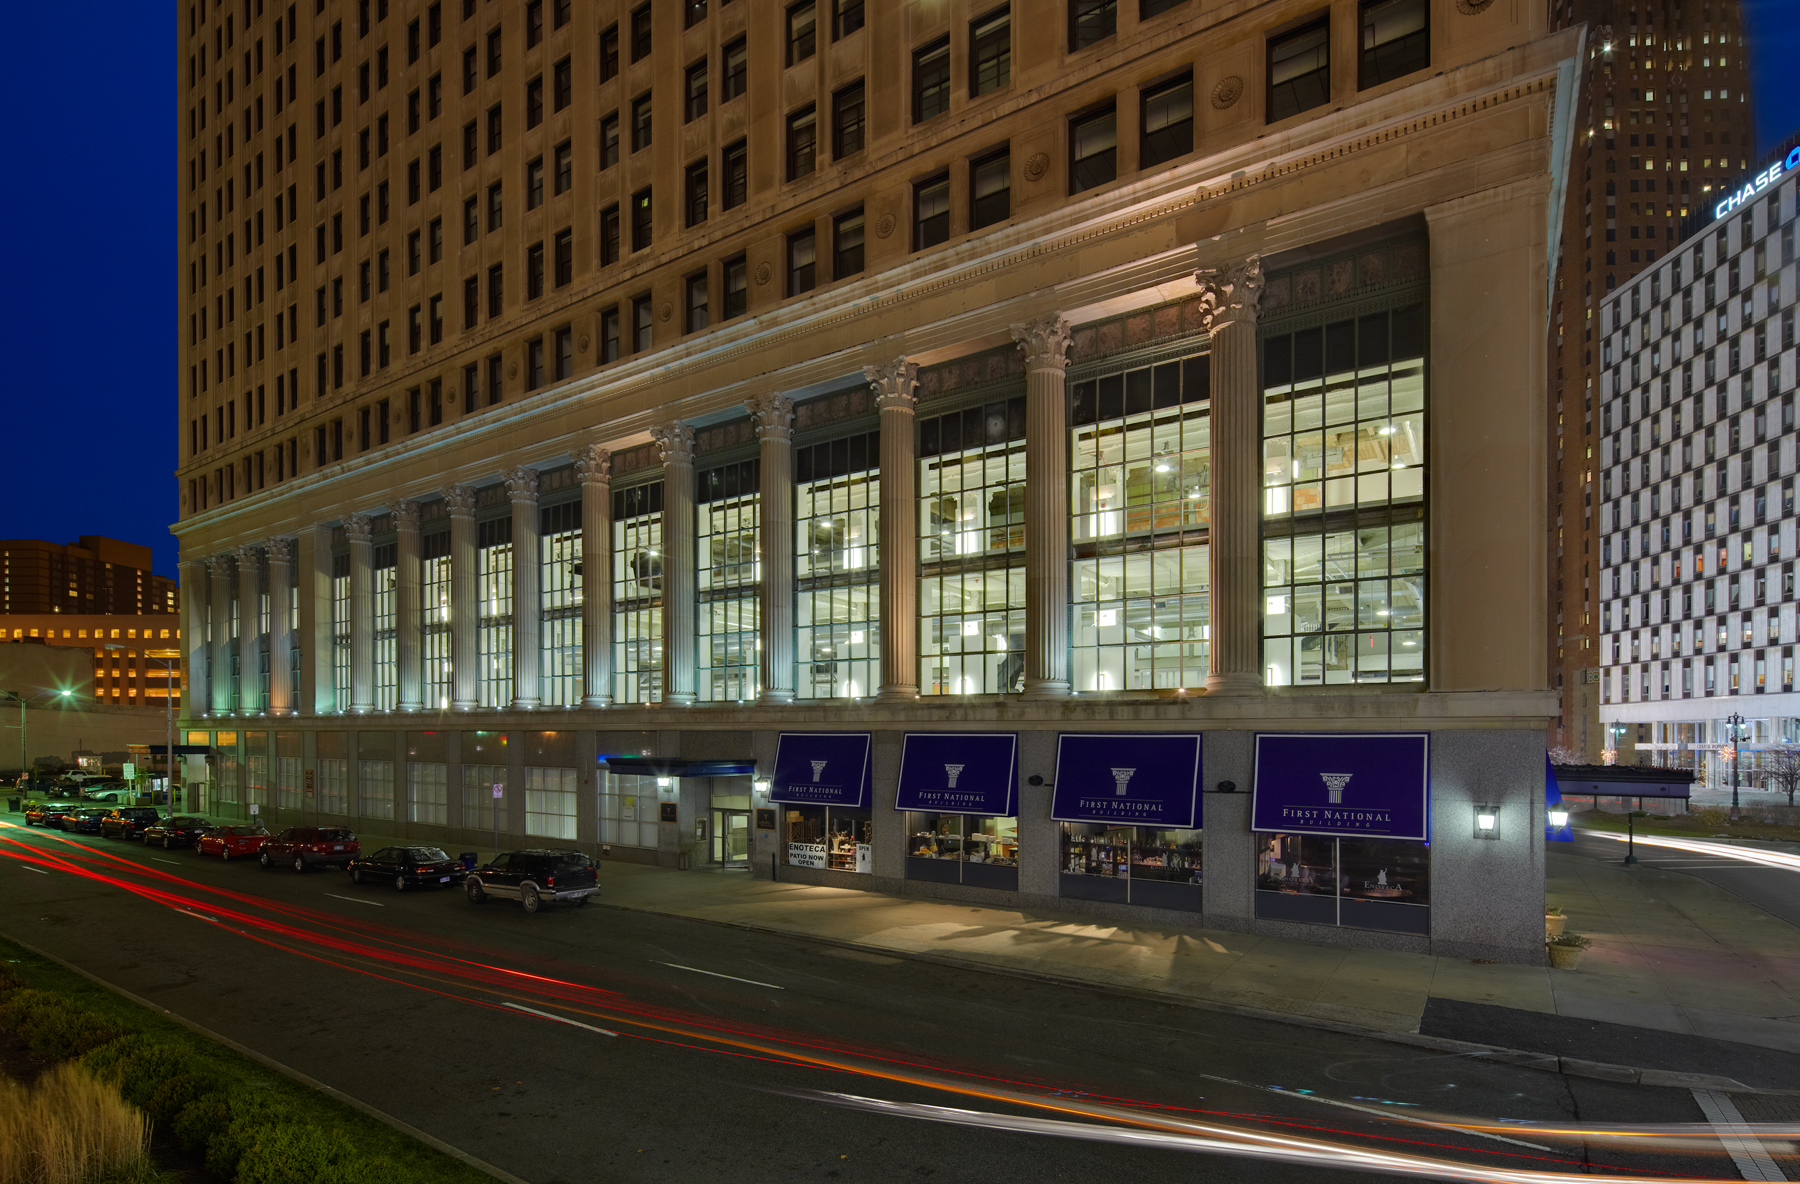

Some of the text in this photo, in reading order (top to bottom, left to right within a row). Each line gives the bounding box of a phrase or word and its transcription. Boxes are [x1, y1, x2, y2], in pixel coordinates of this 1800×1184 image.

[1715, 160, 1783, 220] CHASE
[788, 785, 843, 795] FIRST NATIONAL
[918, 791, 985, 802] FIRST NATIONAL
[1079, 800, 1163, 811] FIRST NATIONAL
[1282, 808, 1391, 821] FIRST NATIONAL
[789, 843, 826, 853] ENOTECA
[1364, 881, 1403, 891] ENOTECA
